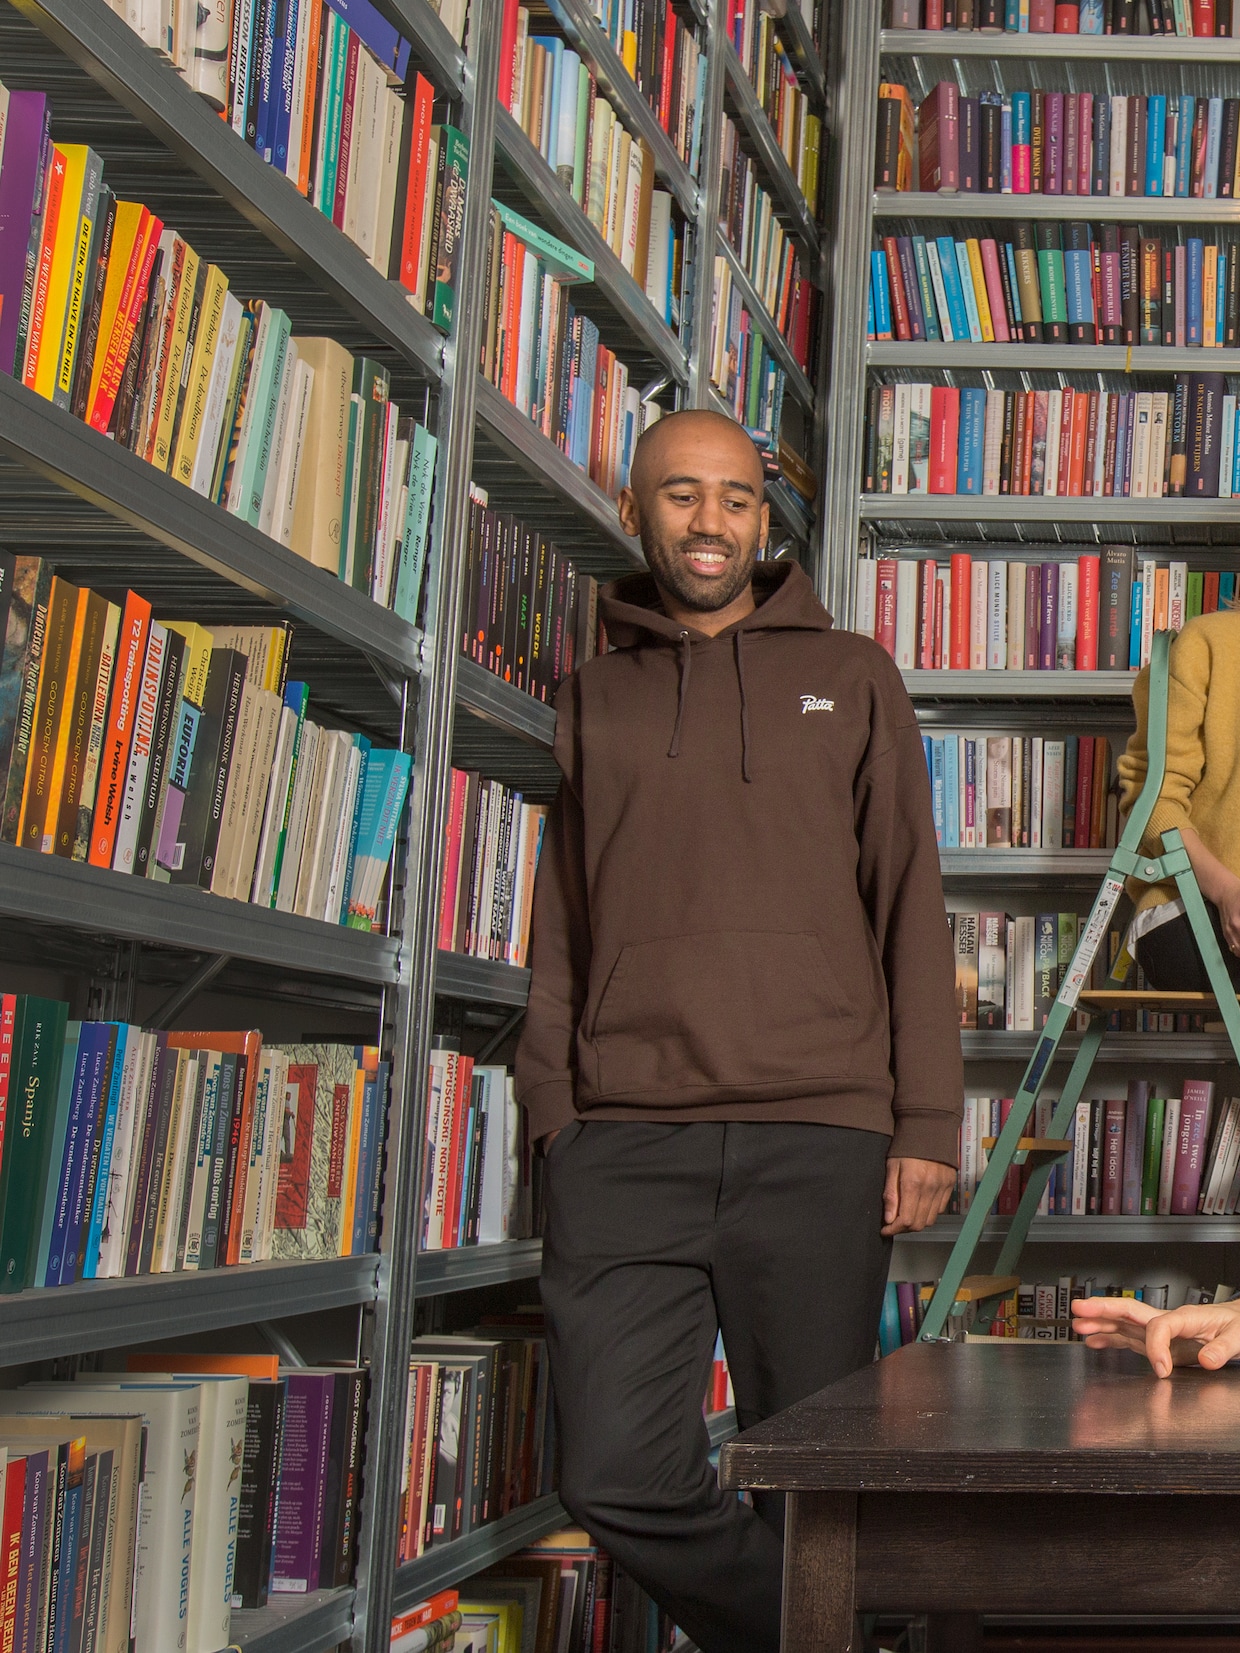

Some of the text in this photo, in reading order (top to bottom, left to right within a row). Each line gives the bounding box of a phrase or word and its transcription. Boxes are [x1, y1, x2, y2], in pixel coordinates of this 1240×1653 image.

[237, 45, 249, 106] BEREZINA
[1033, 127, 1041, 176] OVER MANNEN
[84, 169, 97, 214] Rob Veer
[446, 179, 458, 254] DWAASHEID
[455, 178, 467, 239] DE MARS
[504, 212, 517, 225] Een
[515, 218, 529, 234] boek
[527, 227, 538, 239] van
[19, 250, 36, 339] BEWUST HARDLOPEN
[1021, 251, 1032, 285] KIKKERS
[1105, 255, 1115, 322] DE WIJNREPUBLIEK
[1122, 280, 1130, 300] BAR
[26, 246, 52, 379] DE WETENSCHAP VAN TARA
[61, 223, 89, 386] DE TIEN, DE HALVE EN DE HELE
[205, 283, 223, 356] Paul Verhuyck
[99, 311, 126, 390] MENSEN ALS IK
[189, 365, 209, 440] De doodbieren
[334, 366, 348, 498] Albert Verwey Dichtspel
[882, 389, 890, 421] motto
[1173, 383, 1182, 443] MAANSTORM
[897, 438, 905, 462] [game]
[403, 449, 421, 567] Nyk de Vries Renger
[533, 612, 542, 659] WOEDE
[884, 594, 894, 626] Sefarad
[1109, 571, 1121, 637] Zee en aarde
[18, 604, 48, 754] Danslessen Pieter Waterdrinker
[93, 652, 112, 725] BATTLEBORN
[117, 618, 143, 732] T2 Trainspotting
[799, 694, 835, 714] Patta
[36, 680, 58, 797] GOUD ROEM CITRUS
[148, 655, 178, 809] HERIEN WENSINK KLEIHUID
[174, 713, 195, 787] EUFORIE
[103, 739, 124, 826] Irvine Welsh
[376, 764, 403, 846] IK VERZIN DIT NIET
[386, 775, 407, 840] SYLVIA WITTEMAN
[959, 917, 967, 954] NESSER
[1041, 958, 1051, 998] PAYBACK
[22, 1075, 40, 1138] Spanje
[72, 1052, 89, 1120] Lucas Zandberg
[109, 1049, 123, 1106] Peter Zantingh
[231, 1117, 241, 1146] 1946
[1110, 1138, 1118, 1154] Het
[1181, 1113, 1191, 1155] jongens
[1195, 1109, 1205, 1120] In
[58, 1125, 78, 1229] De rendementsdenker
[95, 1113, 116, 1225] WE VERGATEN TE VOETBALLEN
[208, 1157, 224, 1220] Otto's oorlog
[436, 1147, 448, 1216] NON-FICTIE
[1189, 1144, 1199, 1169] twee
[1060, 1287, 1068, 1314] FIGHT
[348, 1378, 361, 1468] JOOST ZWAGERMAN
[342, 1472, 354, 1556] ALLES IS GEKLEURD
[3, 1531, 21, 1617] IK BEN GEEN
[178, 1508, 192, 1619] ALLE VOGELS
